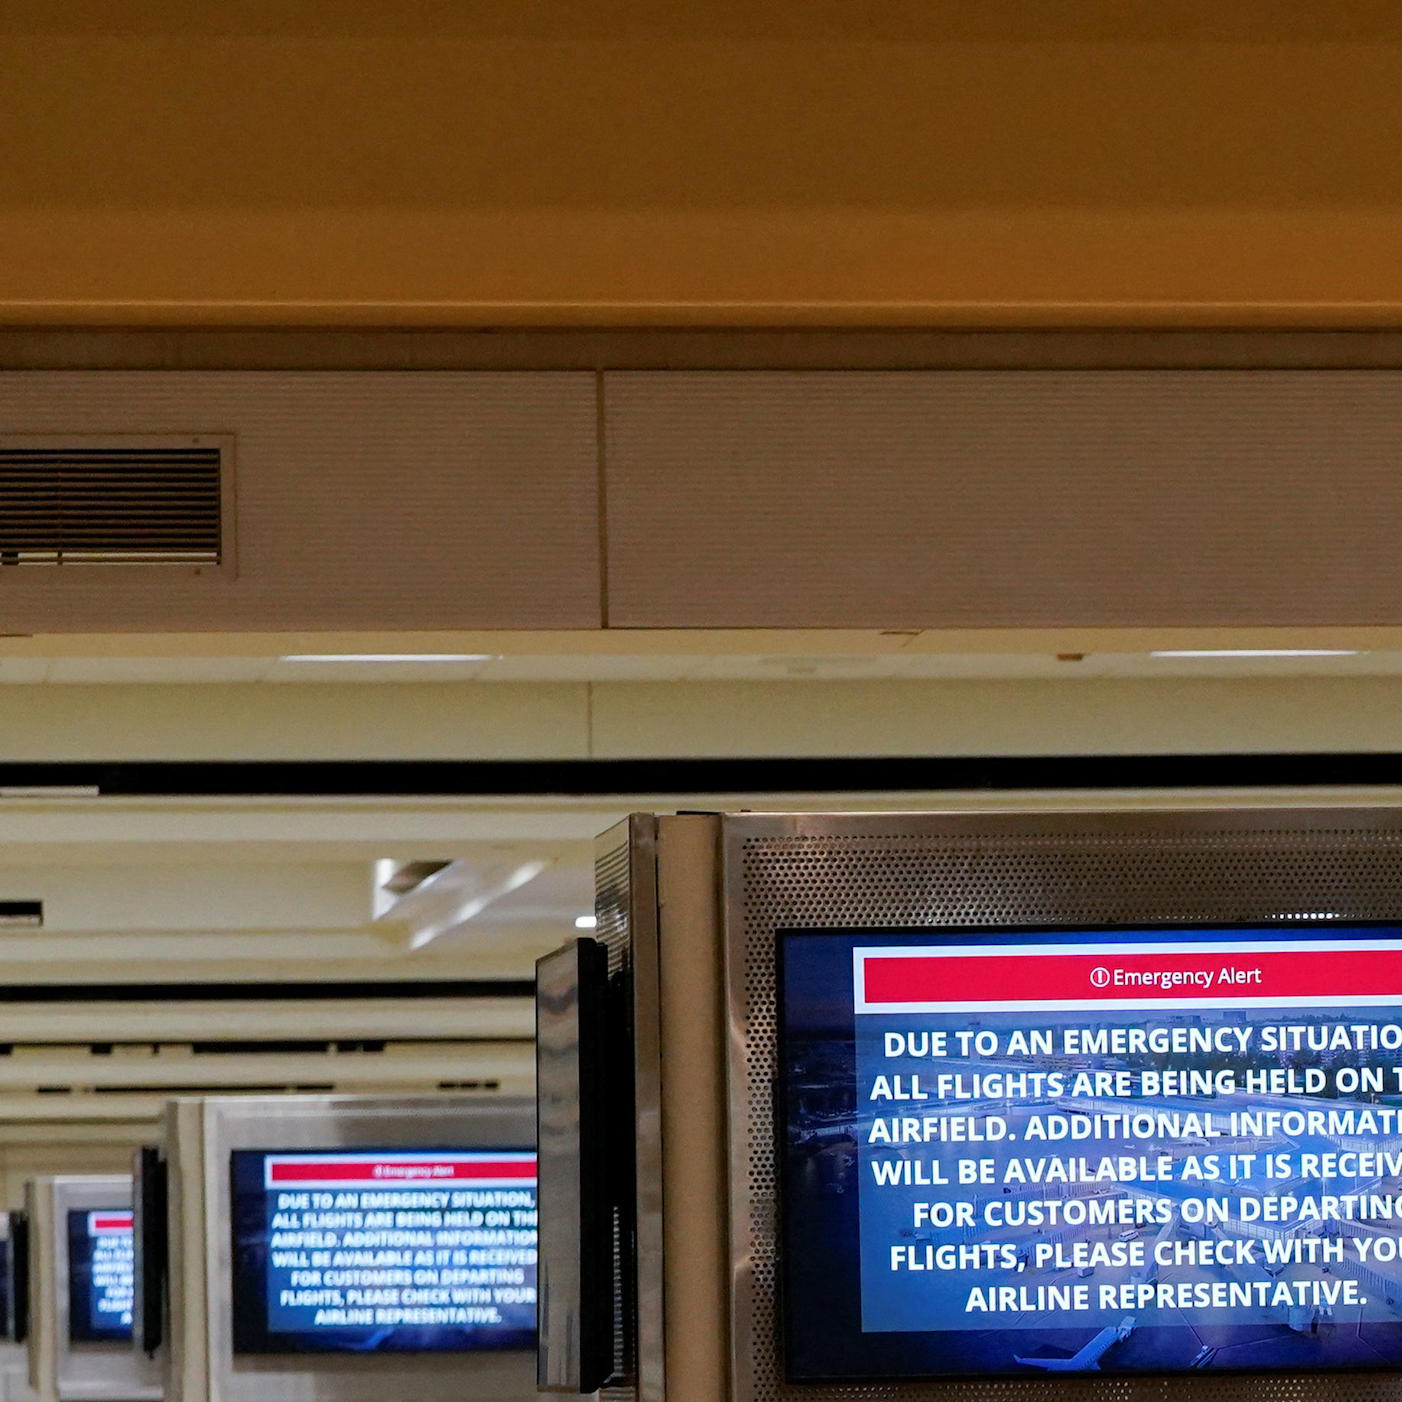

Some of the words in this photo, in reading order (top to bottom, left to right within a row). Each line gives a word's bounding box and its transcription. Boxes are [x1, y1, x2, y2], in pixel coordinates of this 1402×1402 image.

[1114, 969, 1214, 989] Emergency
[1218, 967, 1261, 984] Alert
[886, 1033, 946, 1056] DUE
[956, 1032, 997, 1055] TO
[1008, 1031, 1052, 1054] AN
[1065, 1028, 1252, 1053] EMERGENCY
[871, 1076, 927, 1099] ALL
[939, 1073, 1063, 1098] FLIGHTS
[1072, 1072, 1130, 1096] ARE
[1142, 1070, 1234, 1095] BEING
[1247, 1070, 1325, 1093] HELD
[1337, 1068, 1382, 1092] ON
[869, 1117, 1015, 1142] AIRFIELD.
[1025, 1114, 1220, 1139] ADDITIONAL
[872, 1161, 948, 1184] WILL
[960, 1160, 994, 1183] BE
[1004, 1157, 1172, 1182] AVAILABLE
[1182, 1156, 1219, 1179] AS
[1231, 1156, 1255, 1178] IT
[1267, 1155, 1290, 1178] IS
[279, 1194, 308, 1208] DUE
[313, 1194, 333, 1208] TO
[335, 1194, 358, 1208] AN
[361, 1193, 449, 1208] EMERGENCY
[915, 1203, 975, 1226] FOR
[985, 1199, 1171, 1225] CUSTOMERS
[1182, 1199, 1228, 1222] ON
[273, 1214, 299, 1228] ALL
[303, 1213, 362, 1228] FLIGHTS
[365, 1213, 393, 1227] ARE
[396, 1212, 442, 1227] BEING
[444, 1212, 483, 1226] HELD
[486, 1212, 510, 1226] ON
[892, 1245, 1024, 1271] FLIGHTS,
[1037, 1242, 1144, 1267] PLEASE
[1155, 1240, 1255, 1265] CHECK
[1263, 1239, 1343, 1263] WITH
[348, 1290, 399, 1304] PLEASE
[402, 1289, 449, 1304] CHECK
[452, 1289, 491, 1302] WITH
[494, 1288, 536, 1303] YOUR
[966, 1286, 1088, 1311] AIRLINE
[1100, 1281, 1366, 1308] REPRESENTATIVE.
[316, 1309, 373, 1323] AIRLINE
